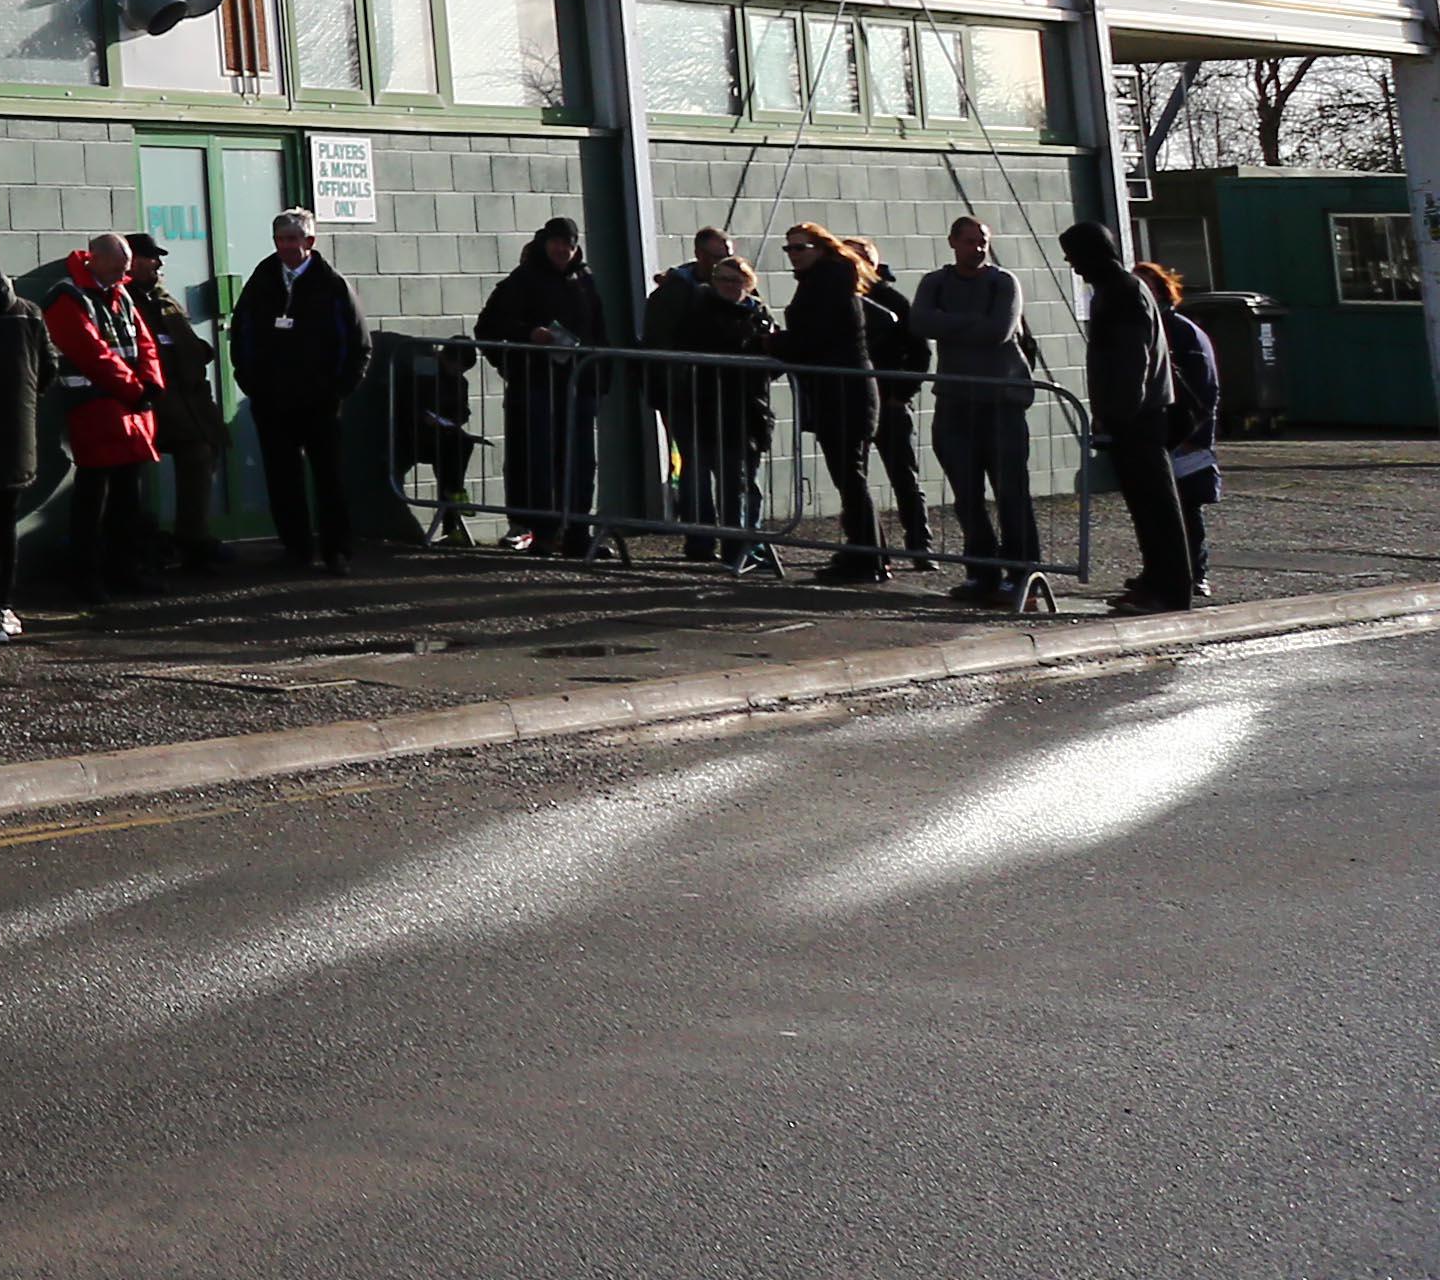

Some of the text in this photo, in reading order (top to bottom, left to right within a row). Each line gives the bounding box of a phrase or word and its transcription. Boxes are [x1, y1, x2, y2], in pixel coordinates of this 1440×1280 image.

[319, 143, 366, 160] PLAYERS
[319, 161, 368, 178] & MATCH
[318, 181, 371, 198] OFFICIALS
[335, 200, 357, 217] ONLY
[146, 205, 207, 240] PULL
